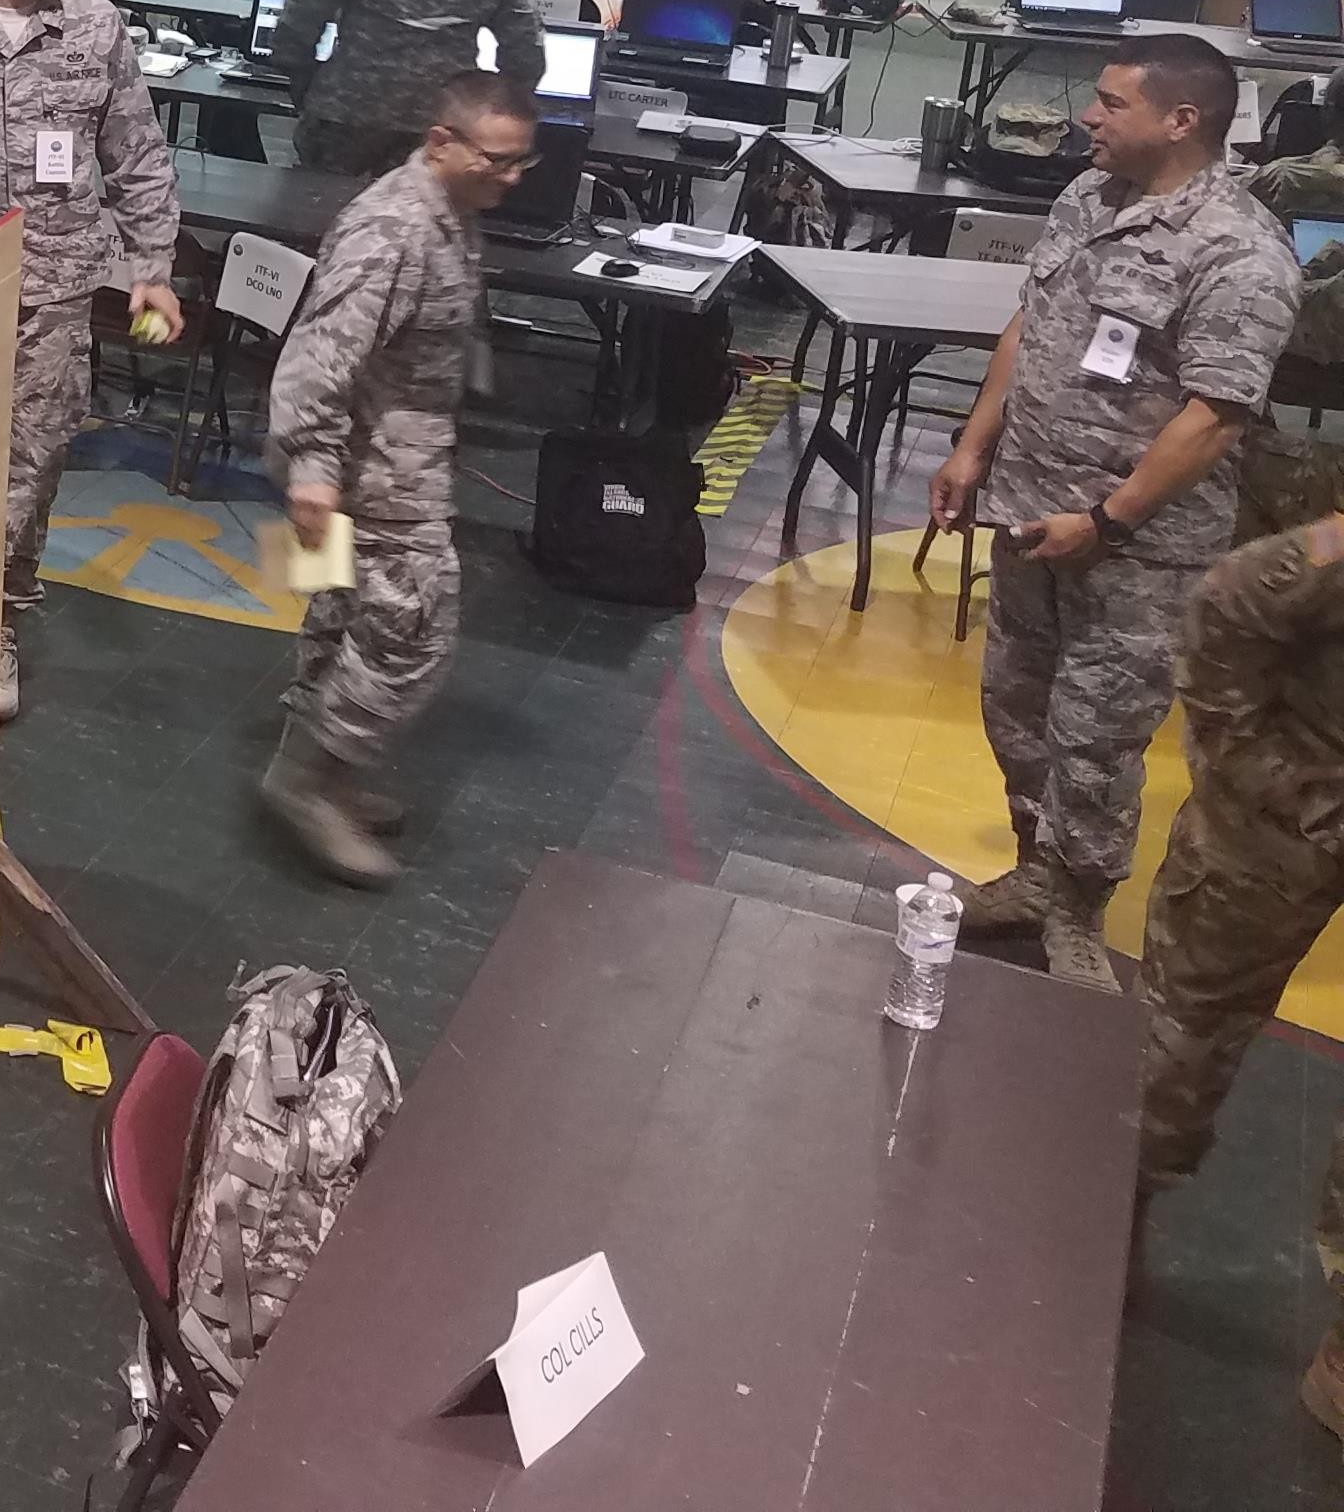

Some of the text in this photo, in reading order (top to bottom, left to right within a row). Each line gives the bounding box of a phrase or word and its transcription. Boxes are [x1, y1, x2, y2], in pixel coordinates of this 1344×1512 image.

[608, 90, 668, 108] LTC CARTER
[989, 239, 1025, 254] JTF-VI
[246, 277, 283, 300] DCO LNO
[541, 1306, 604, 1384] COL CILLS
